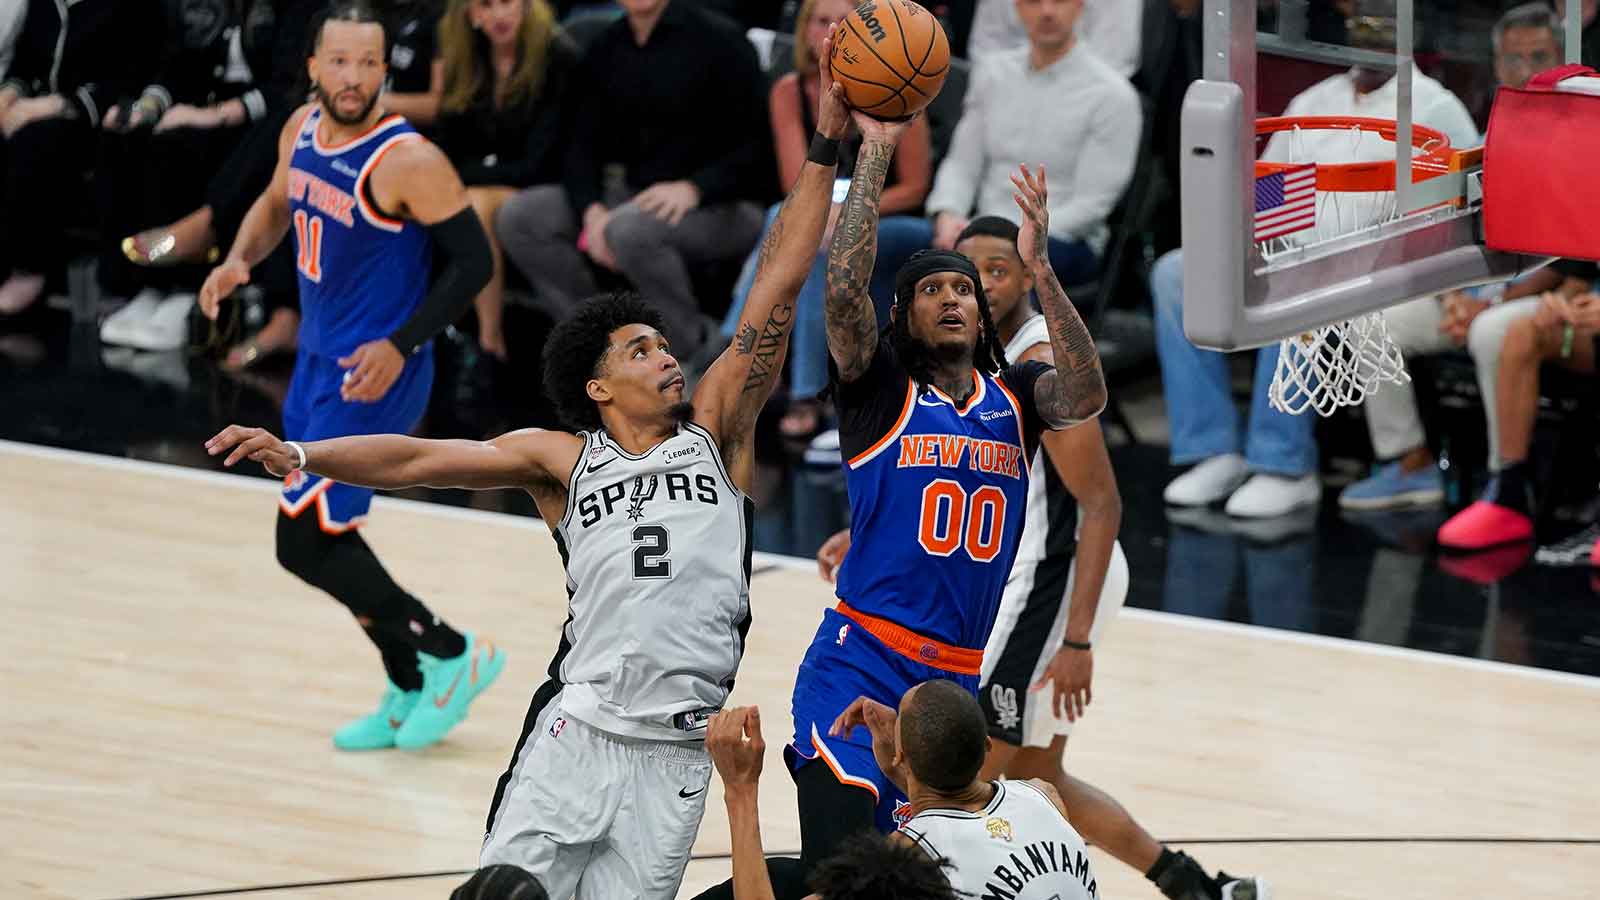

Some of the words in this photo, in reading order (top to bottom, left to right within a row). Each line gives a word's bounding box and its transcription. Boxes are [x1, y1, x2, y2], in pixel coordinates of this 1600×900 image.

[294, 208, 323, 283] 11
[743, 303, 791, 393] WAWG
[668, 446, 696, 460] LEDGER
[897, 434, 969, 468] NEW
[967, 438, 1021, 480] YORK
[578, 472, 719, 529] SPURS
[918, 478, 1008, 563] 00
[631, 522, 672, 580] 2
